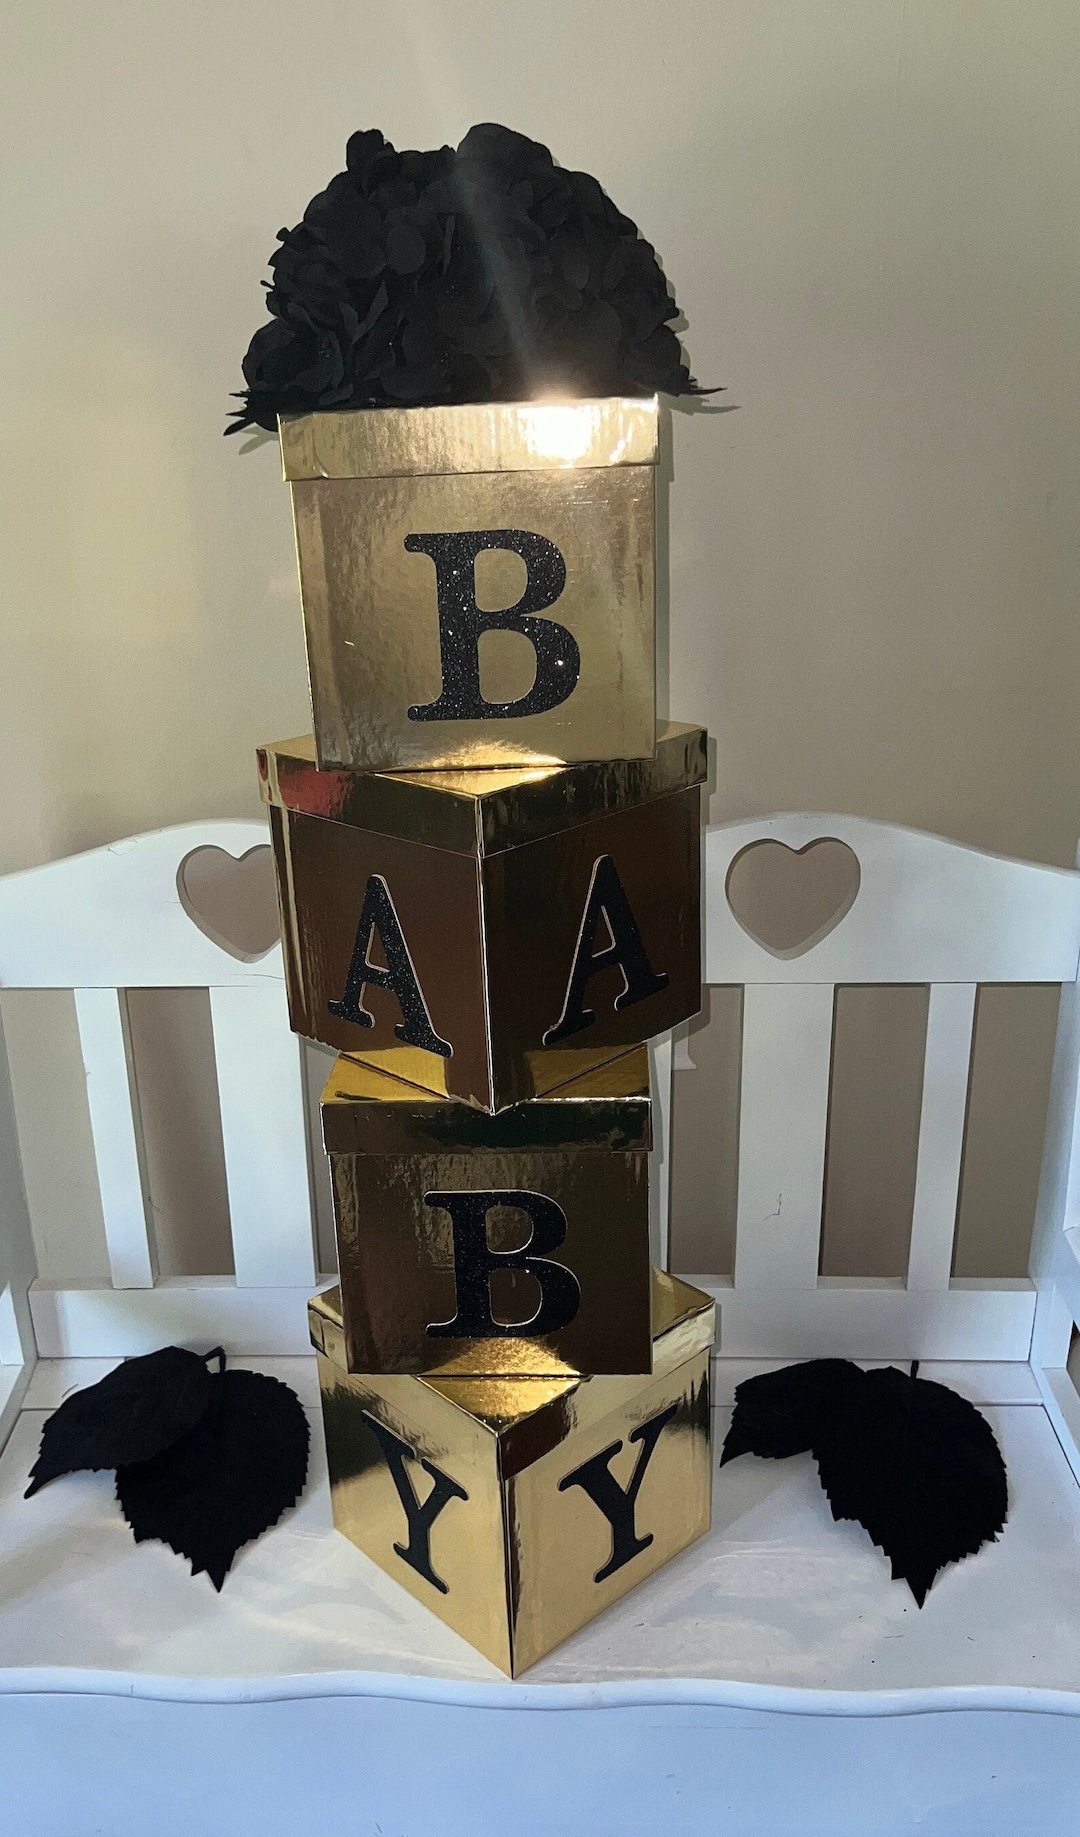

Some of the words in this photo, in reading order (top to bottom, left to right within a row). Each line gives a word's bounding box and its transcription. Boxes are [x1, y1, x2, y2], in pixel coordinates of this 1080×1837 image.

[404, 529, 581, 721] B
[328, 874, 453, 1058] A
[542, 855, 669, 1046] A
[424, 1189, 581, 1338] B
[361, 1408, 469, 1595] Y
[557, 1404, 678, 1583] Y
